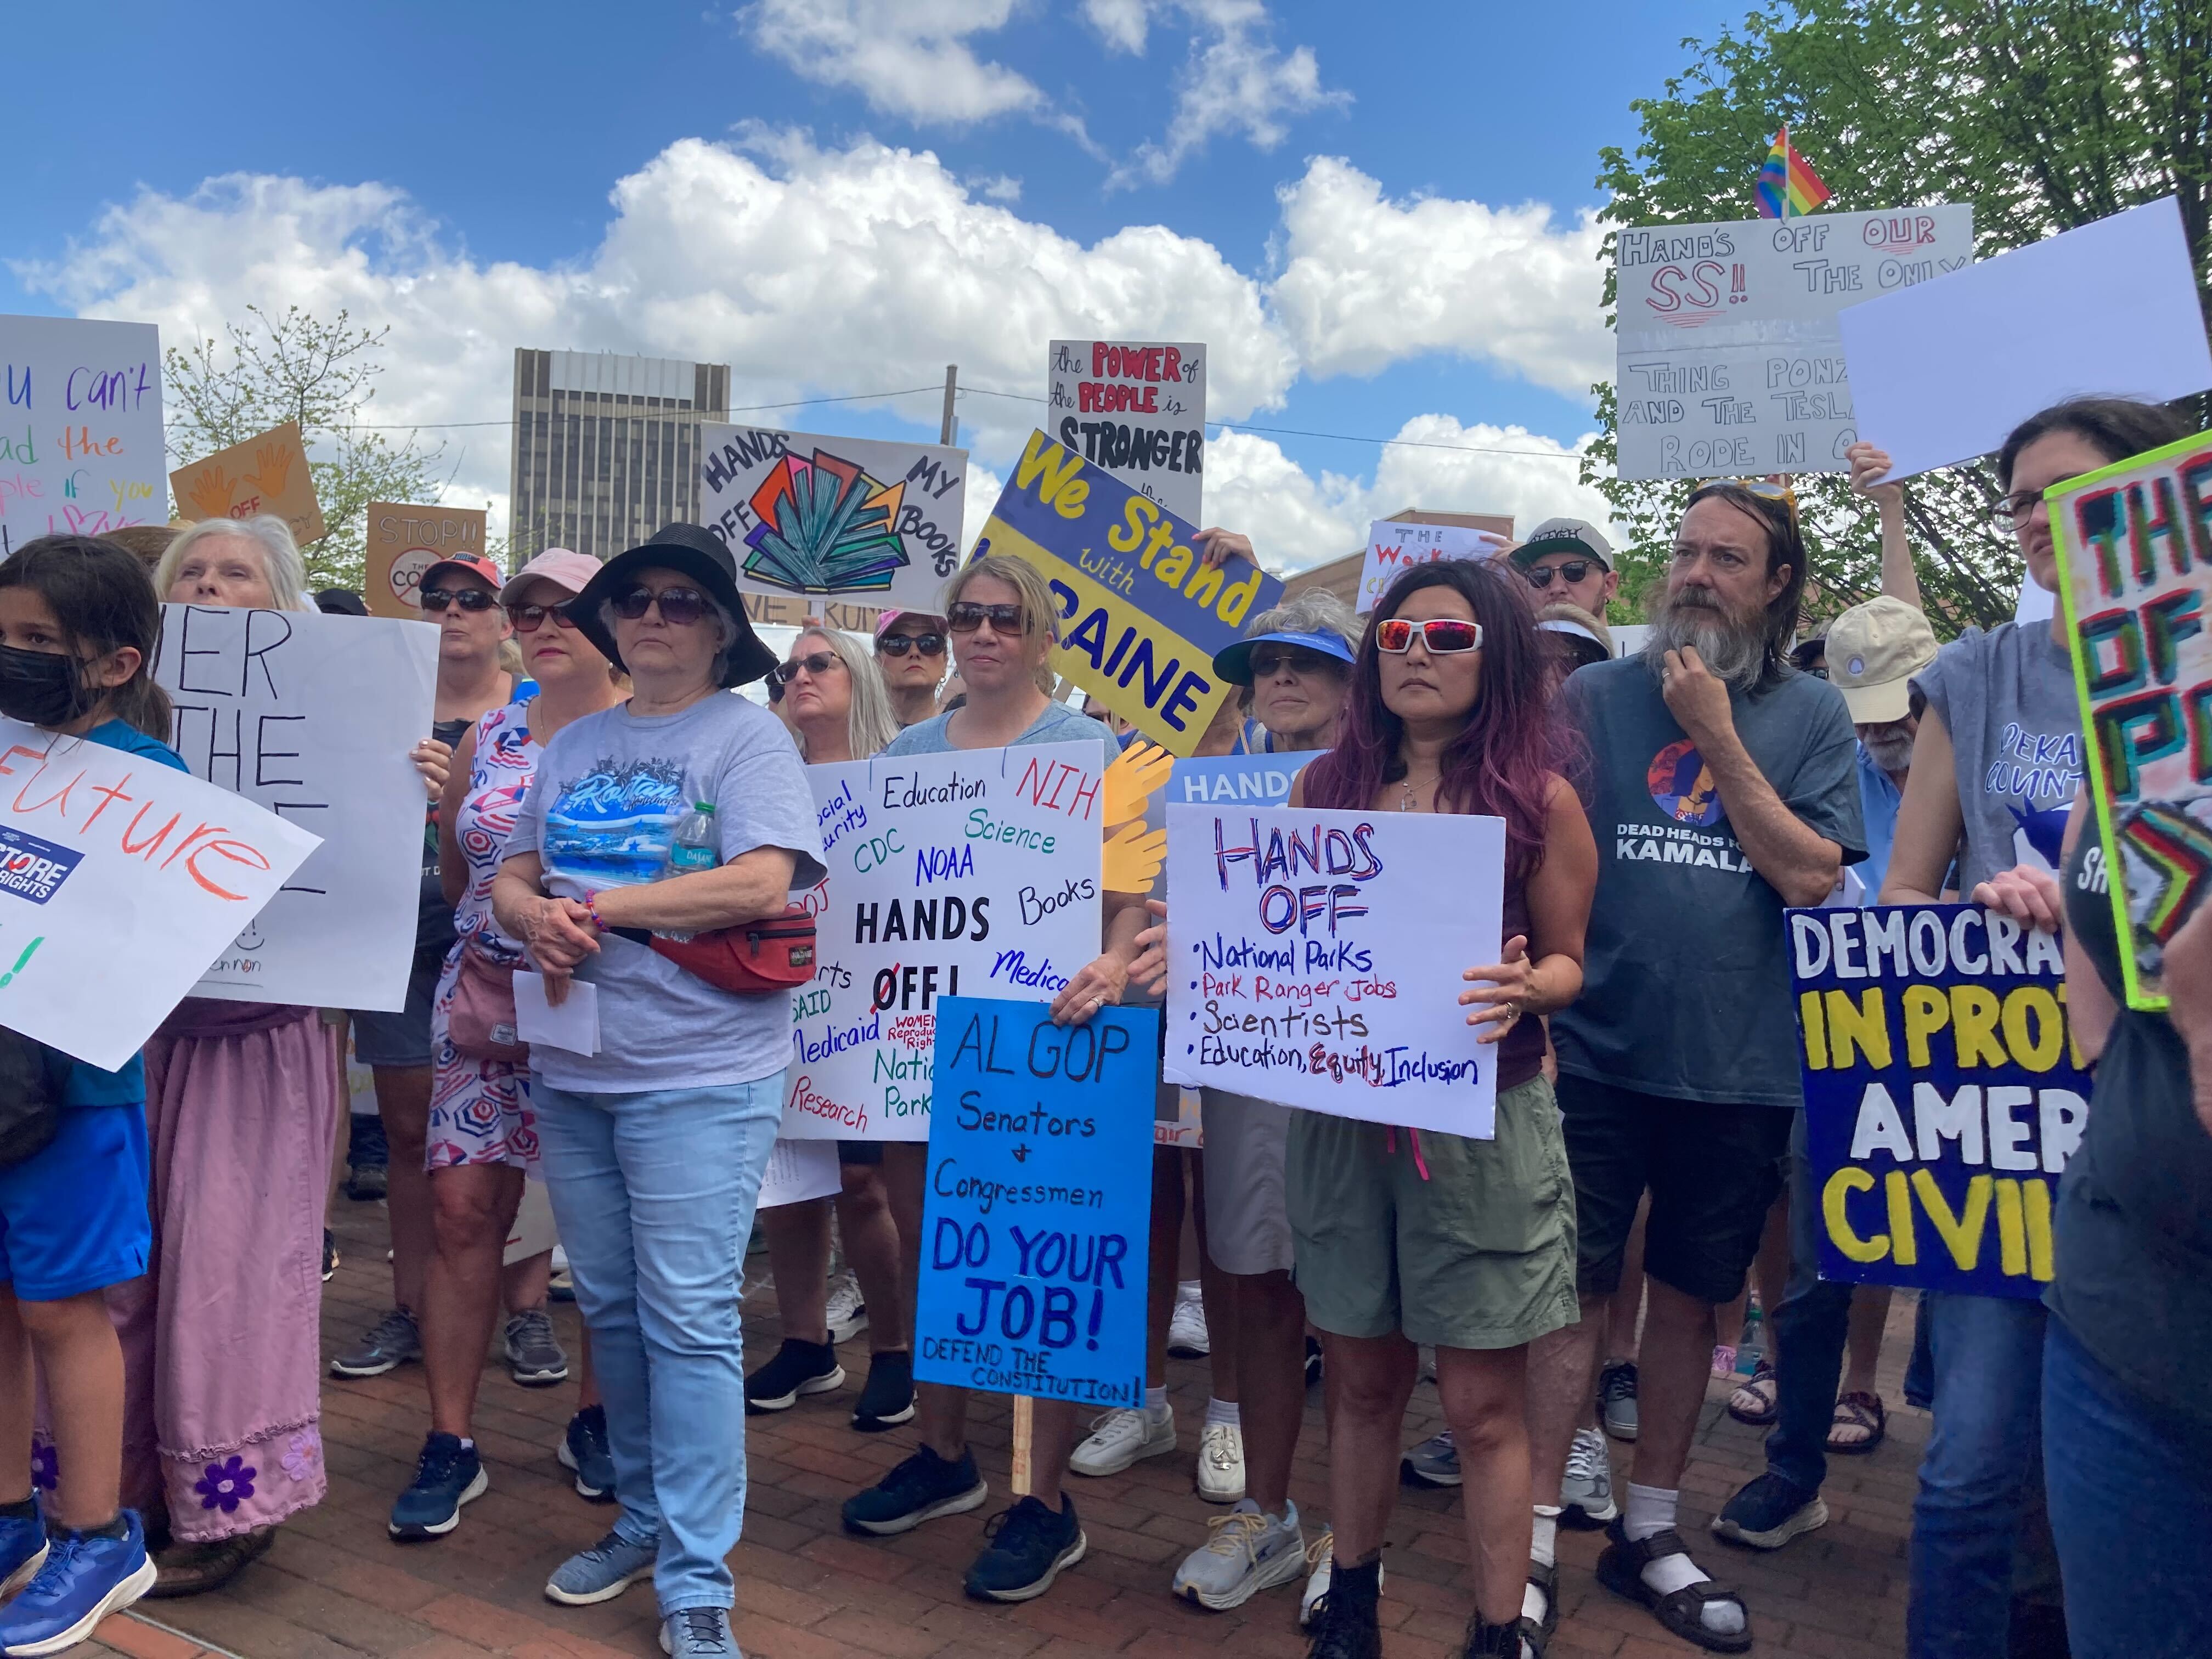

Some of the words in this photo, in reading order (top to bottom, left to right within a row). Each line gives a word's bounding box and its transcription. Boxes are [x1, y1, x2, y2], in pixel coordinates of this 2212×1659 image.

[1773, 224, 1830, 253] OFF
[1863, 217, 1936, 245] OUR
[1646, 260, 1748, 312] SS!!
[1793, 259, 1863, 294] THE
[1052, 345, 1082, 373] the
[1092, 342, 1182, 382] POWER
[1182, 359, 1199, 383] of
[1628, 362, 1730, 393] THING
[1049, 382, 1075, 408] the
[1078, 382, 1159, 413] PEOPLE
[1162, 396, 1187, 415] is
[1622, 400, 1684, 424] AND
[1701, 397, 1756, 425] THE
[58, 426, 123, 460] the
[701, 428, 789, 493] HANDS
[1060, 416, 1203, 474] STRONGER
[1661, 436, 1754, 472] RODE
[1776, 433, 1805, 464] IN
[110, 478, 153, 512] you
[906, 455, 960, 499] MY
[230, 495, 260, 519] OFF
[707, 499, 751, 545] OFF
[379, 515, 477, 549] STOP!!
[900, 505, 959, 578] BOOKS
[1015, 433, 1091, 519] We
[1107, 495, 1263, 628] Stand
[1395, 528, 1443, 543] THE
[1079, 548, 1135, 596] with
[2077, 587, 2202, 702] OF
[173, 706, 306, 792] THE
[883, 771, 986, 809] Education
[1015, 757, 1101, 820] NIH
[1184, 769, 1301, 803] HAND
[0, 745, 271, 901] Future
[964, 808, 1056, 854] Science
[1617, 823, 1664, 837] DEAD
[1667, 827, 1724, 847] HEADS
[854, 828, 905, 873] CDC
[916, 844, 974, 886] NOAA
[1214, 817, 1383, 892] HANDS
[1616, 838, 1753, 874] KAMALA
[855, 896, 990, 944] HANDS
[1018, 878, 1096, 926] Books
[1259, 884, 1369, 938] OFF
[814, 961, 852, 989] rts
[1201, 932, 1295, 975] National
[1255, 975, 1340, 1007] Ranger
[1344, 973, 1397, 1001] Jobs
[1203, 1000, 1369, 1040] Scientists
[1800, 987, 1892, 1070] IN
[950, 1012, 1015, 1075] AL
[1027, 1020, 1130, 1084] GOP
[1200, 1035, 1307, 1074] Education,
[1384, 1046, 1478, 1087] Inclusion
[790, 1075, 868, 1133] Research
[956, 1090, 1096, 1137] Senators
[934, 1158, 1103, 1213] Congressmen
[932, 1216, 990, 1271] DO
[1009, 1225, 1127, 1290] YOUR
[956, 1277, 1103, 1351] JOB!
[923, 1335, 1002, 1366] DEFEND
[1014, 1347, 1052, 1374] THE
[972, 1365, 1141, 1408] CONSTITUTION!
